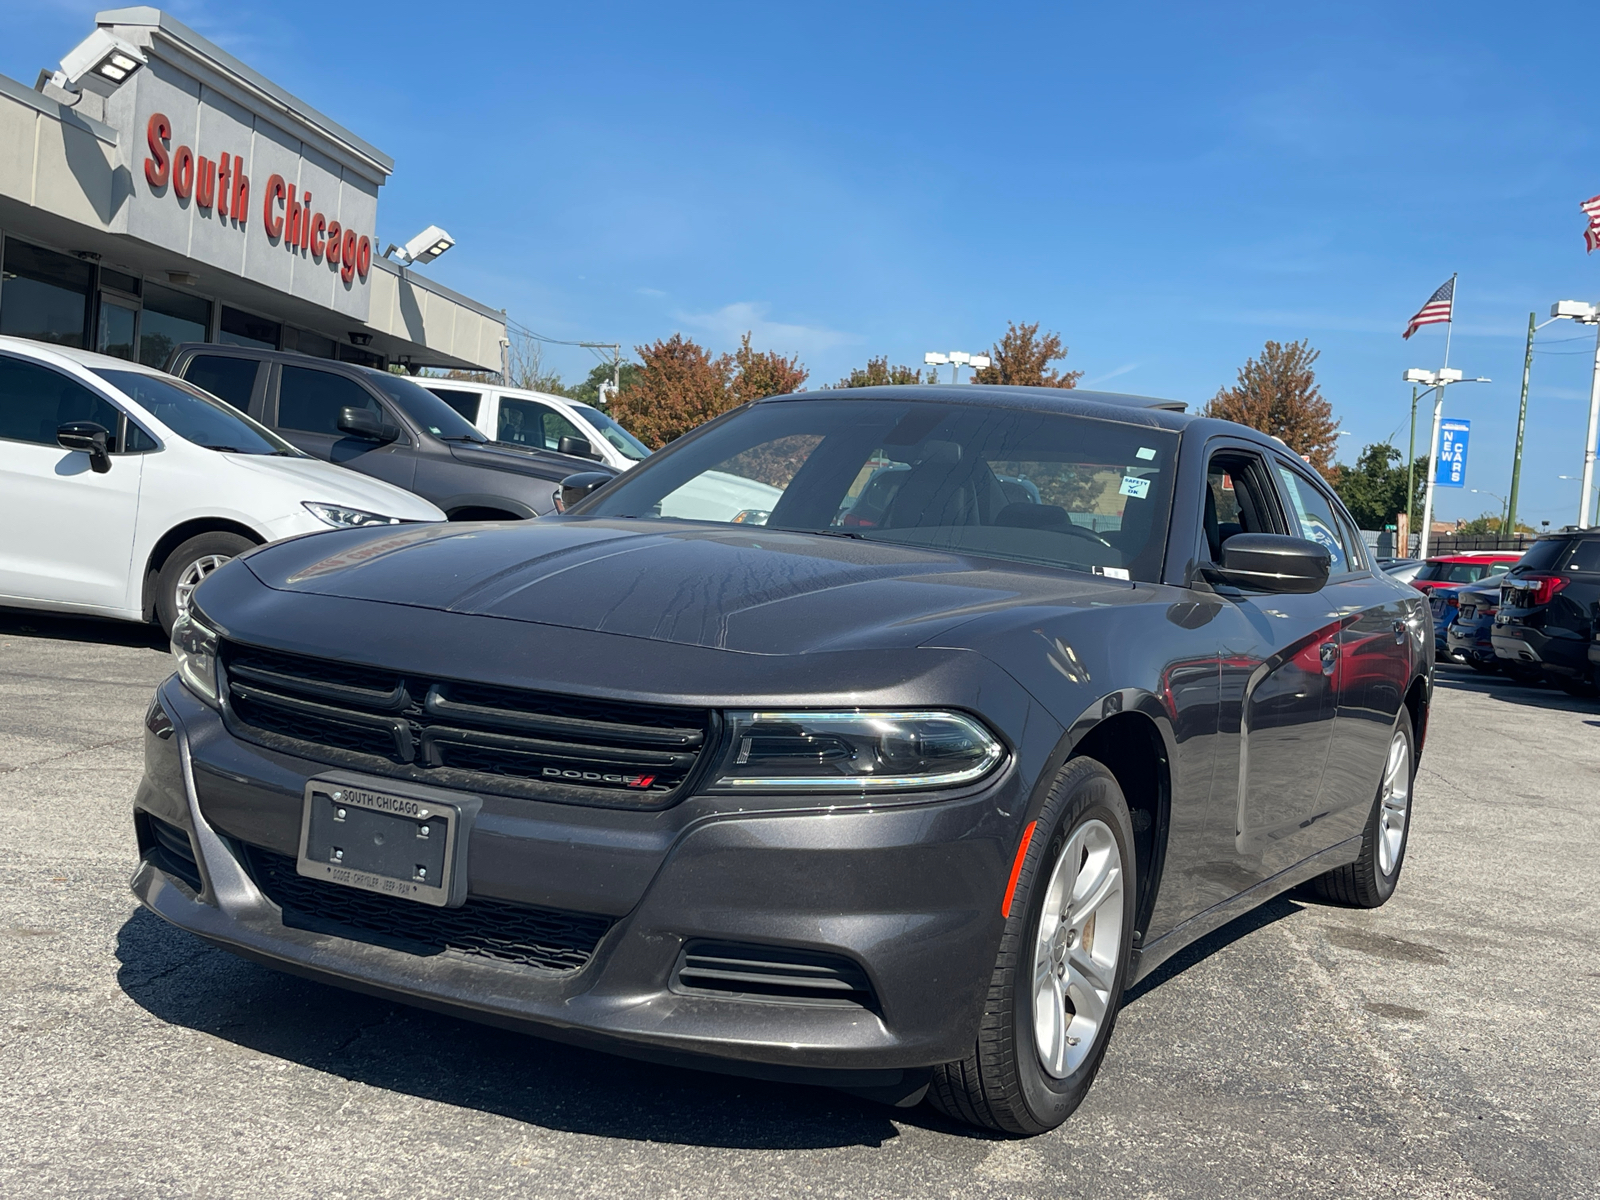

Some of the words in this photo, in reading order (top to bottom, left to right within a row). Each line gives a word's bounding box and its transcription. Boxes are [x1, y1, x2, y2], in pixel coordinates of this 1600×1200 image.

[145, 112, 250, 223] South
[264, 174, 371, 283] Chicago
[1441, 431, 1454, 462] NEW
[1450, 443, 1464, 482] CARS
[1124, 478, 1148, 486] SAFETY
[542, 767, 642, 784] DODGE
[342, 789, 374, 807] SOUTH
[376, 797, 419, 816] CHICAGO
